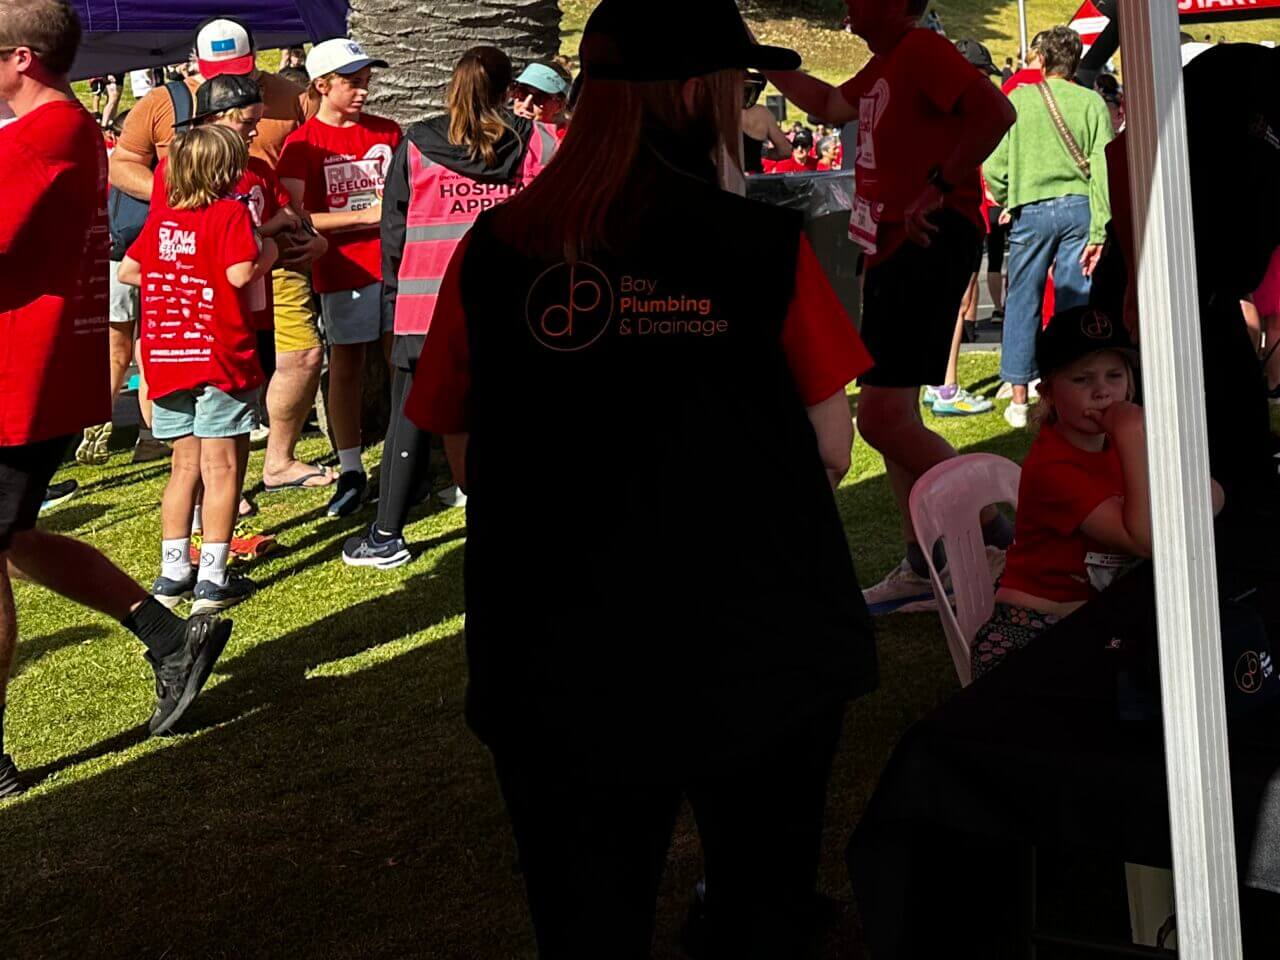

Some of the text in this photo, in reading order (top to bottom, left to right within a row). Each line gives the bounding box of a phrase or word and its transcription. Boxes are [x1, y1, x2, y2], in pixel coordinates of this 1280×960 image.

[329, 177, 384, 194] GEELONG
[440, 180, 526, 198] HOSPITA
[450, 198, 504, 214] APP
[620, 275, 658, 296] Bay
[620, 295, 712, 315] Plumbing
[619, 316, 729, 336] & Drainage
